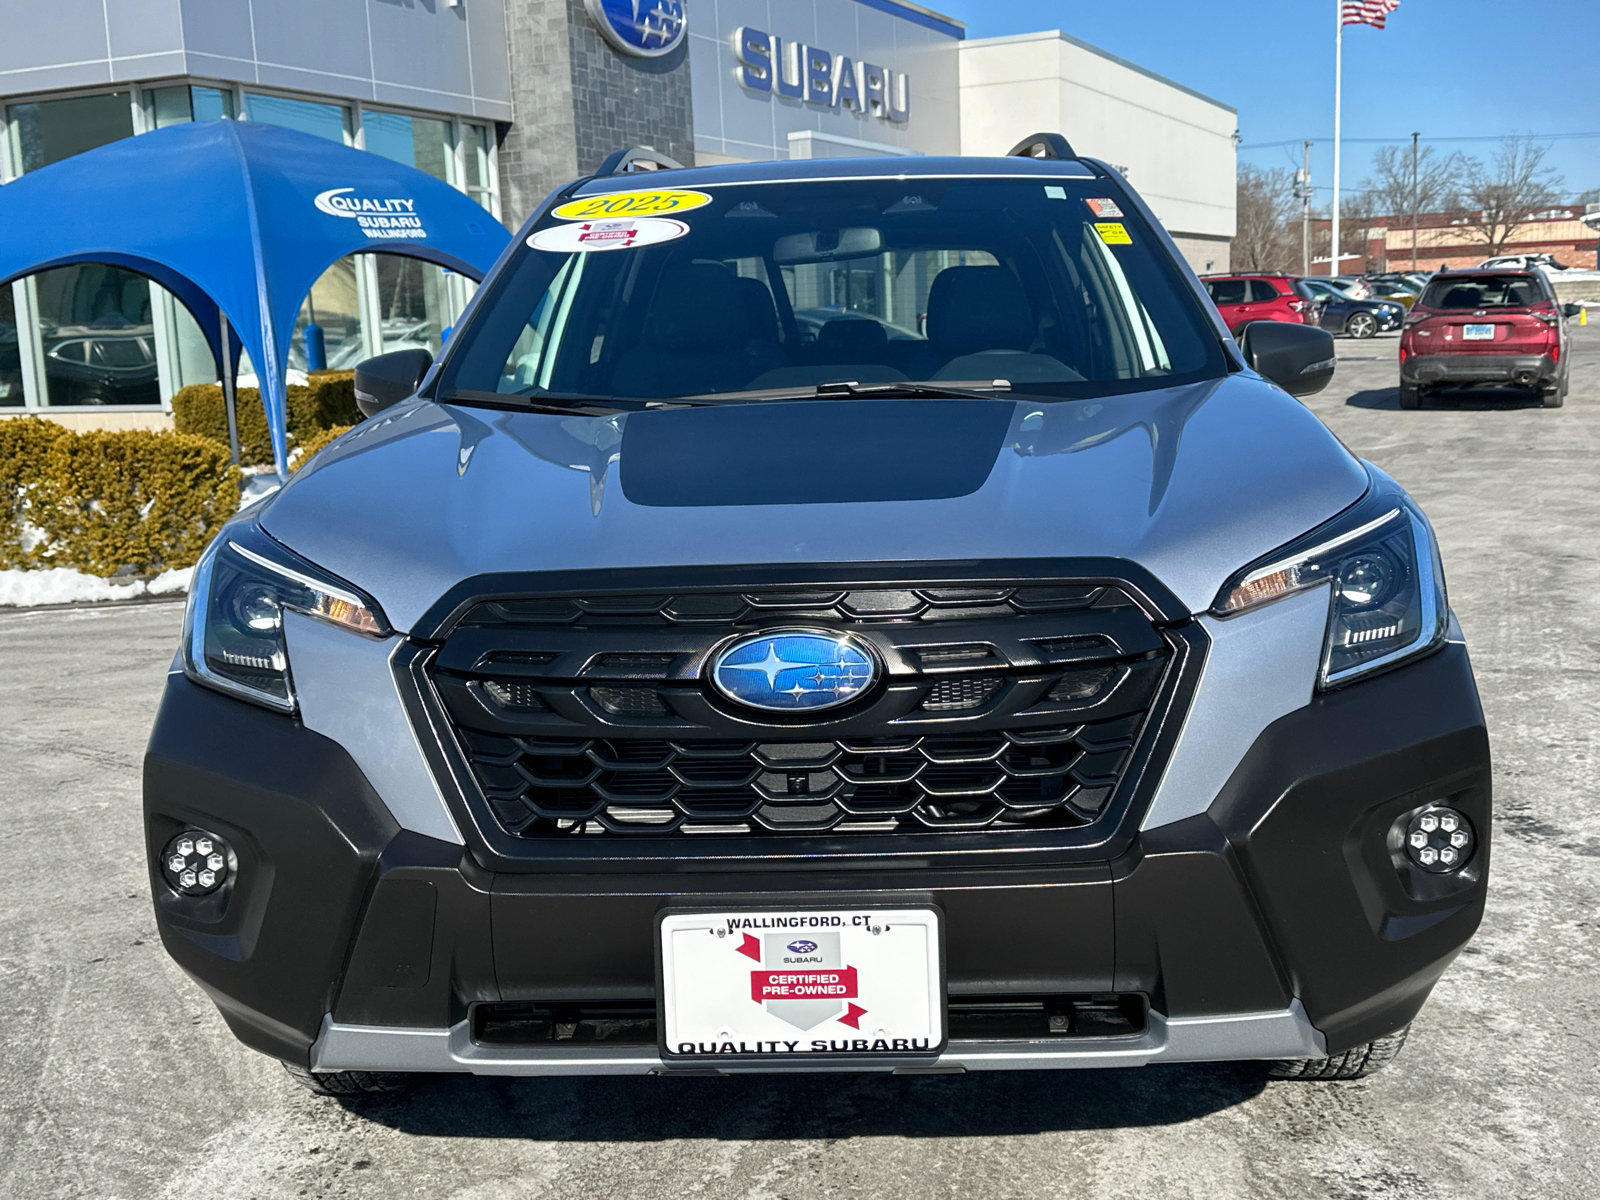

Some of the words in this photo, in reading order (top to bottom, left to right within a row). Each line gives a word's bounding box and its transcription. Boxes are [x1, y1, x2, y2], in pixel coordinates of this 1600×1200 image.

[734, 26, 910, 123] SUBARU
[331, 197, 414, 212] QUALITY
[575, 194, 688, 216] 2025
[356, 216, 421, 228] SUBARU
[361, 228, 427, 239] WALLINGFORD
[726, 916, 846, 929] WALLINGFORD,
[852, 915, 872, 926] CT
[768, 974, 840, 985] CERTIFIED
[762, 985, 847, 996] PRE-OWNED
[677, 1040, 800, 1054] QUALITY
[811, 1037, 930, 1052] SUBARU
